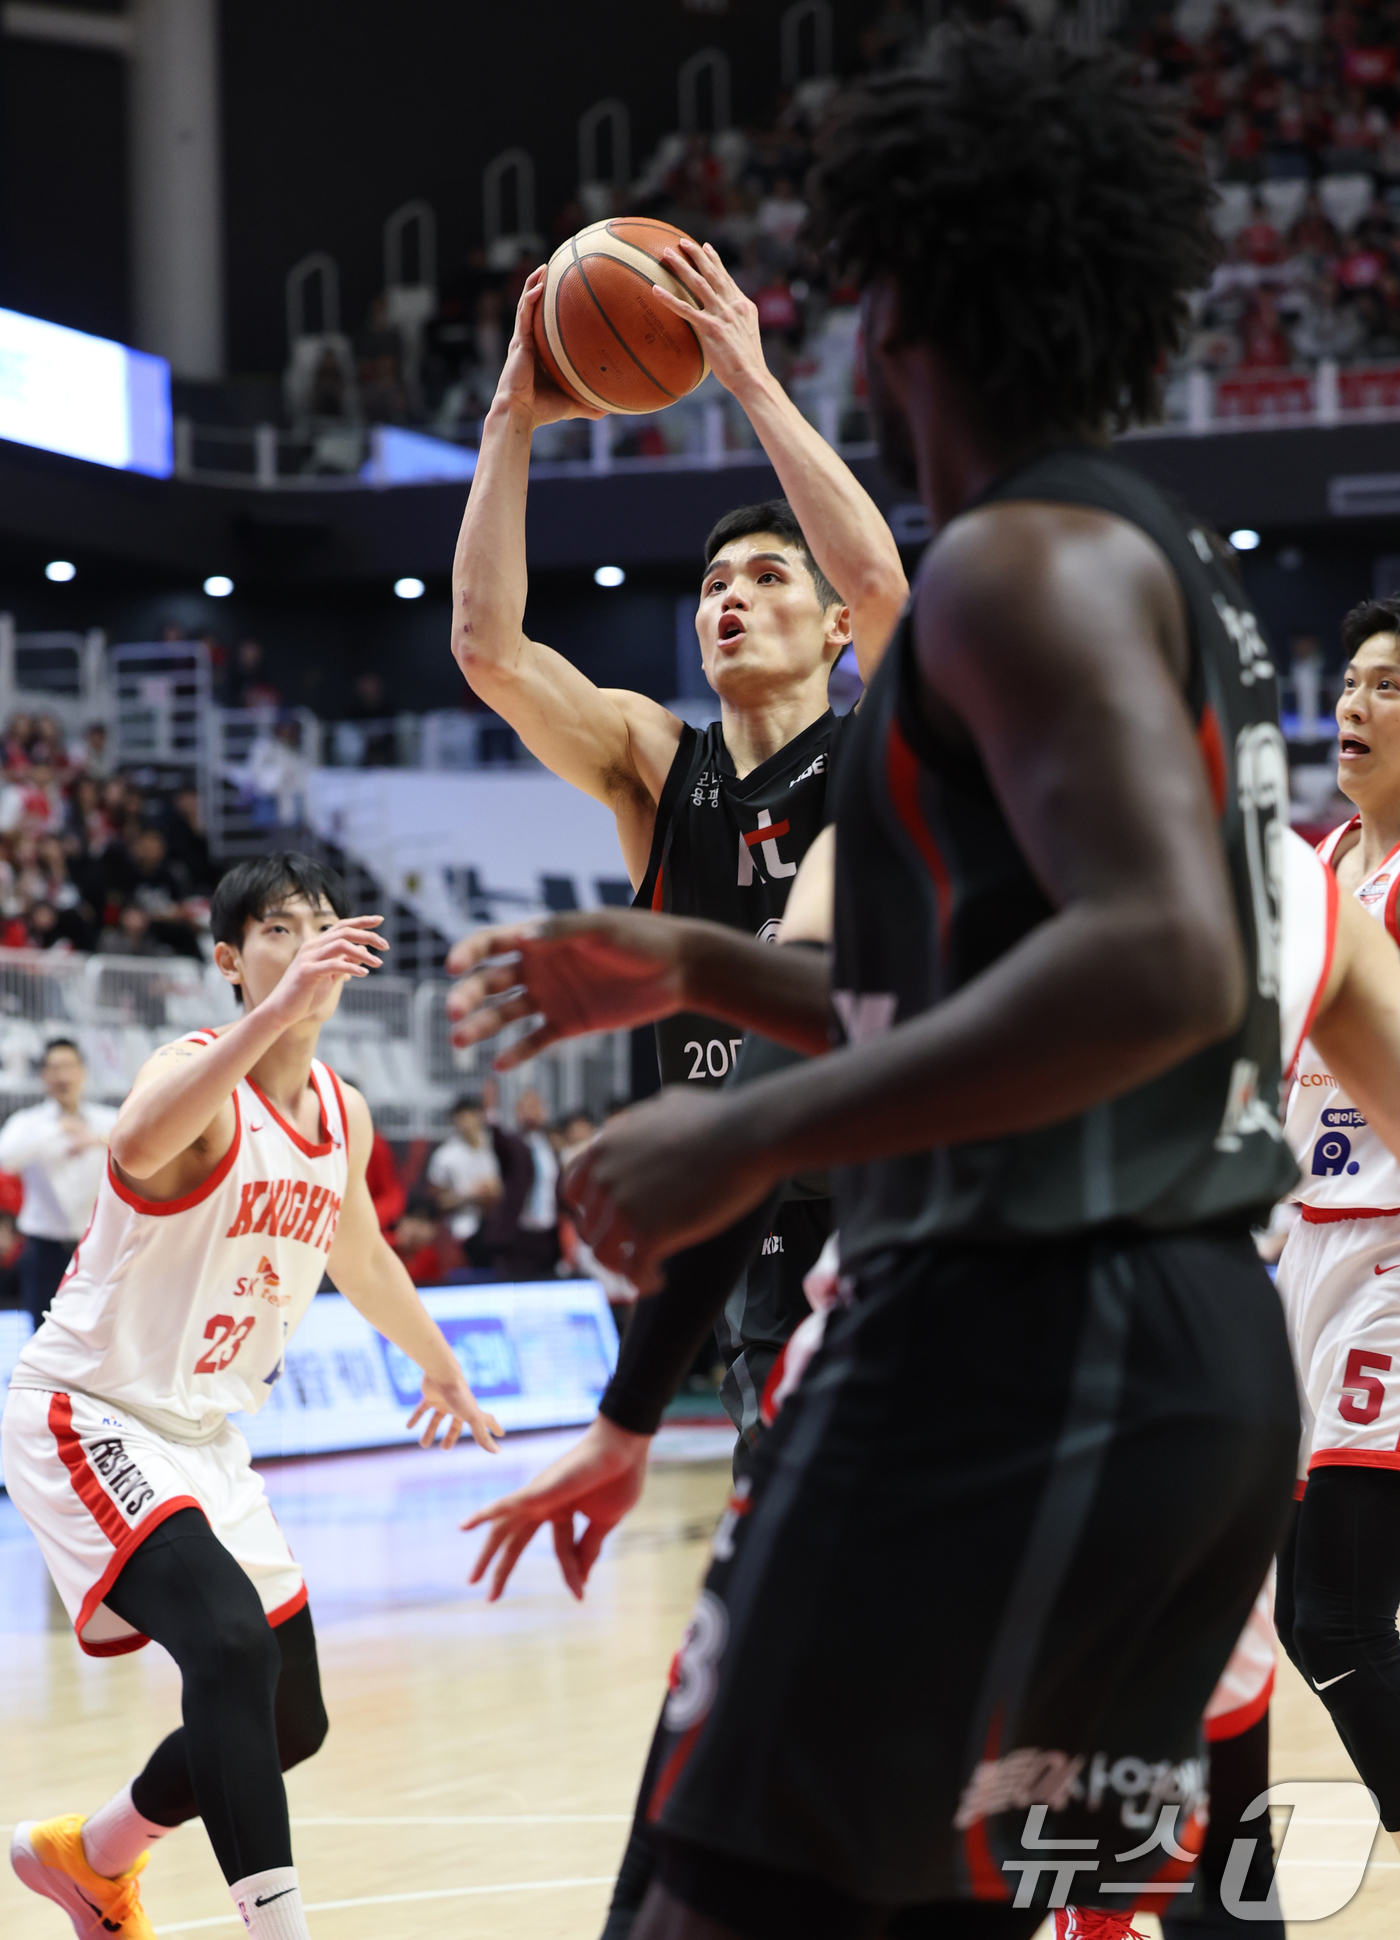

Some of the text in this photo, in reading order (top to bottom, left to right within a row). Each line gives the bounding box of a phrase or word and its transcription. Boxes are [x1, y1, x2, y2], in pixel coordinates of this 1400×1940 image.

[761, 1235, 785, 1255] KBL
[233, 1276, 259, 1297] SK
[193, 1314, 256, 1374] 23
[1338, 1348, 1392, 1425] 5
